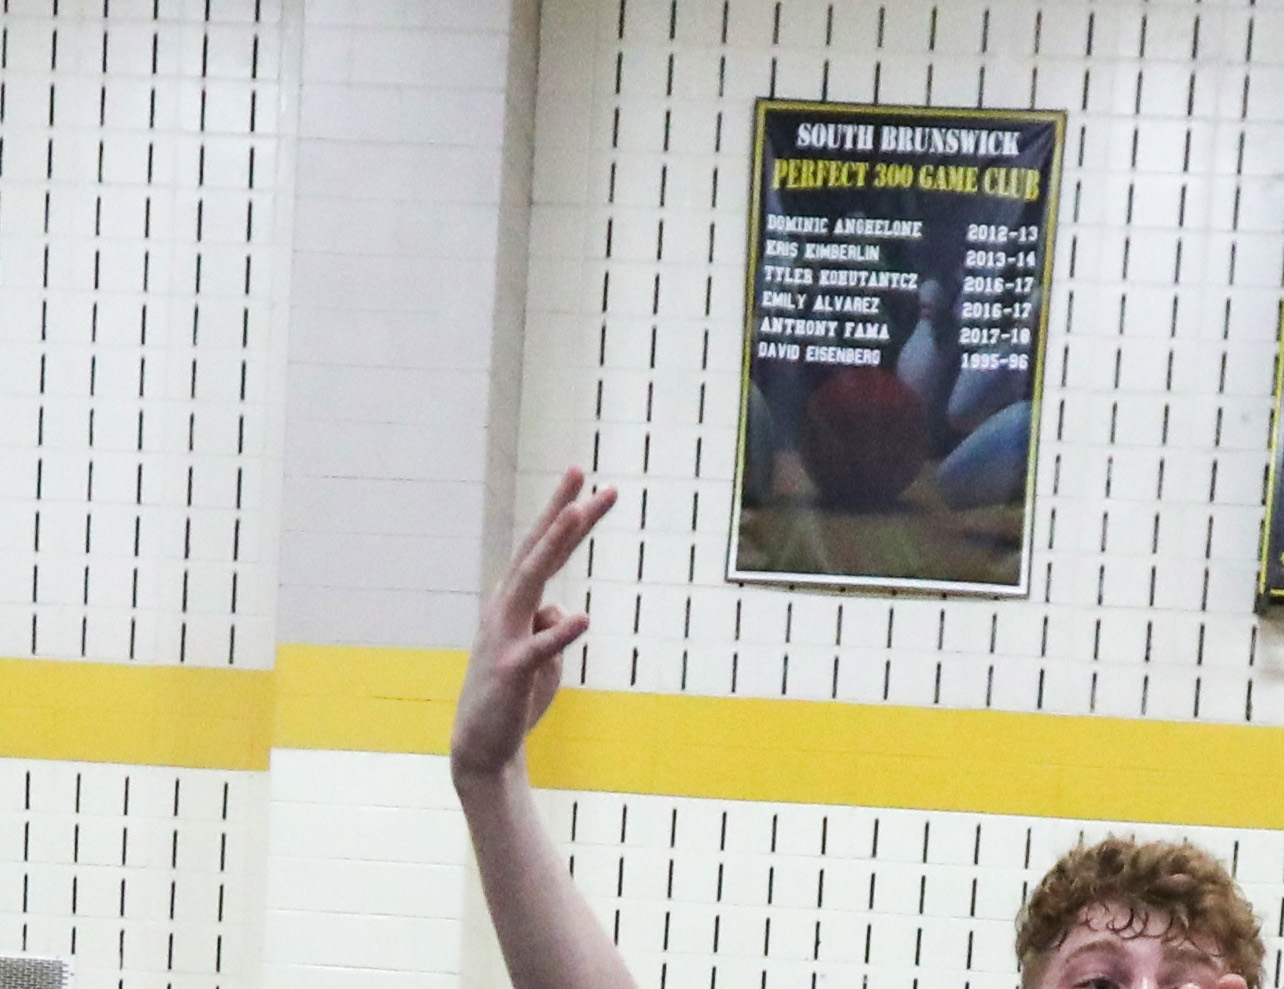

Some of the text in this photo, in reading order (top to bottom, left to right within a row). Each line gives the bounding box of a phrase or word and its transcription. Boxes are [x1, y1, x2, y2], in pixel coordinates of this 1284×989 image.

[796, 122, 1022, 156] SOUTH BRUNSWICK
[772, 158, 1041, 200] PERFECT 300 GAME CLUB
[766, 213, 829, 234] DOMINIC
[967, 223, 1039, 243] 2012-13
[765, 238, 1036, 268] KRIS KIMBERLIN 2013-14
[763, 264, 813, 285] TYLER
[963, 275, 1035, 295] 2016-17
[761, 290, 1032, 320] EMILY ALVAREZ 2016-17
[760, 316, 838, 338] ANTHONY
[843, 321, 890, 340] FAMA
[757, 341, 800, 361] DAVID
[804, 345, 882, 366] EISENBERG
